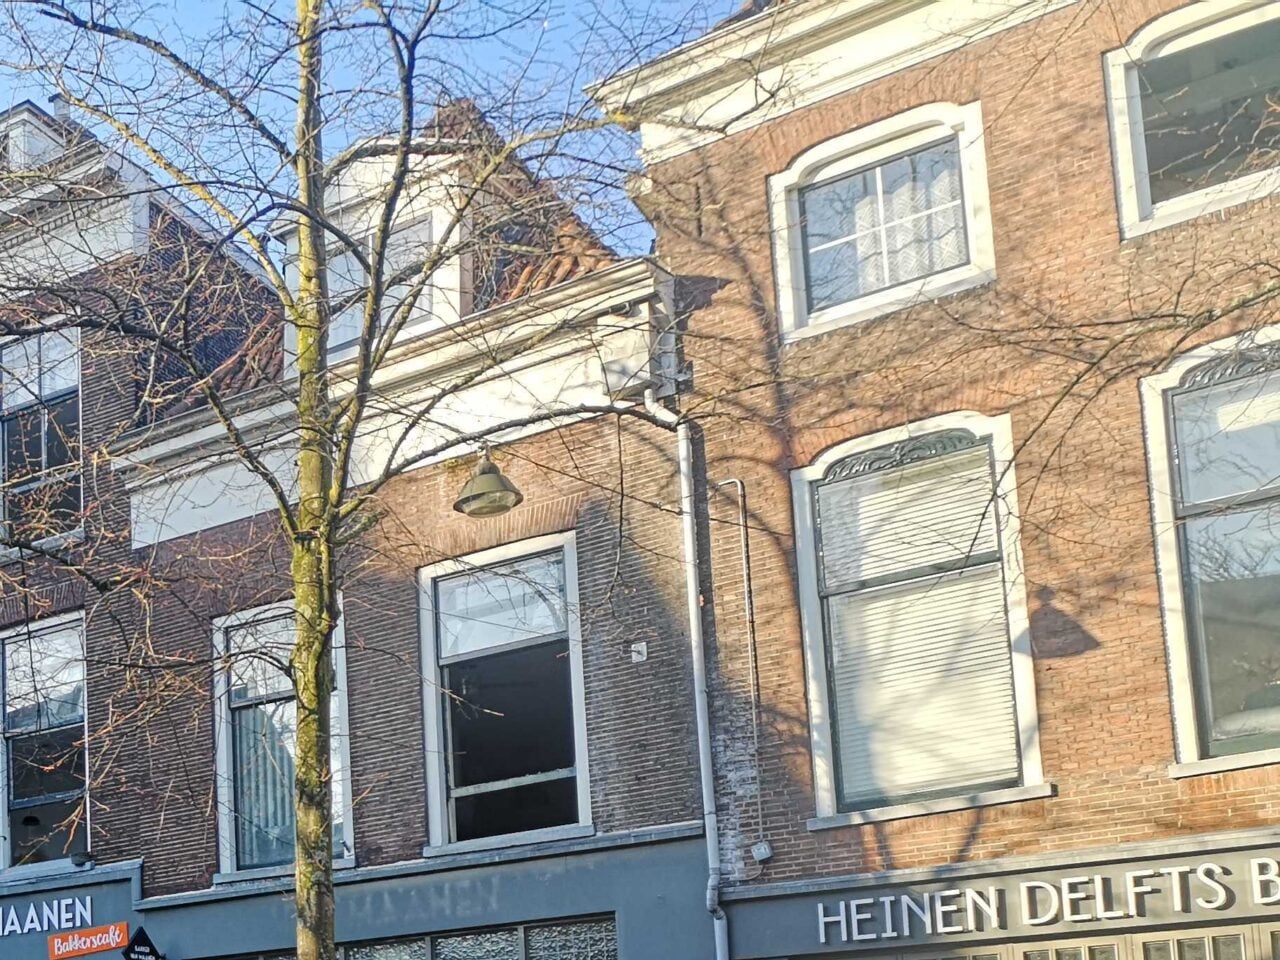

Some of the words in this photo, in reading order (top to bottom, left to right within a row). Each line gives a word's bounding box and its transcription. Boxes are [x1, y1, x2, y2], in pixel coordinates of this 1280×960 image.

[817, 886, 998, 943] HEINEN
[1020, 862, 1227, 926] DELFTS
[54, 925, 124, 956] Bakkerscafé
